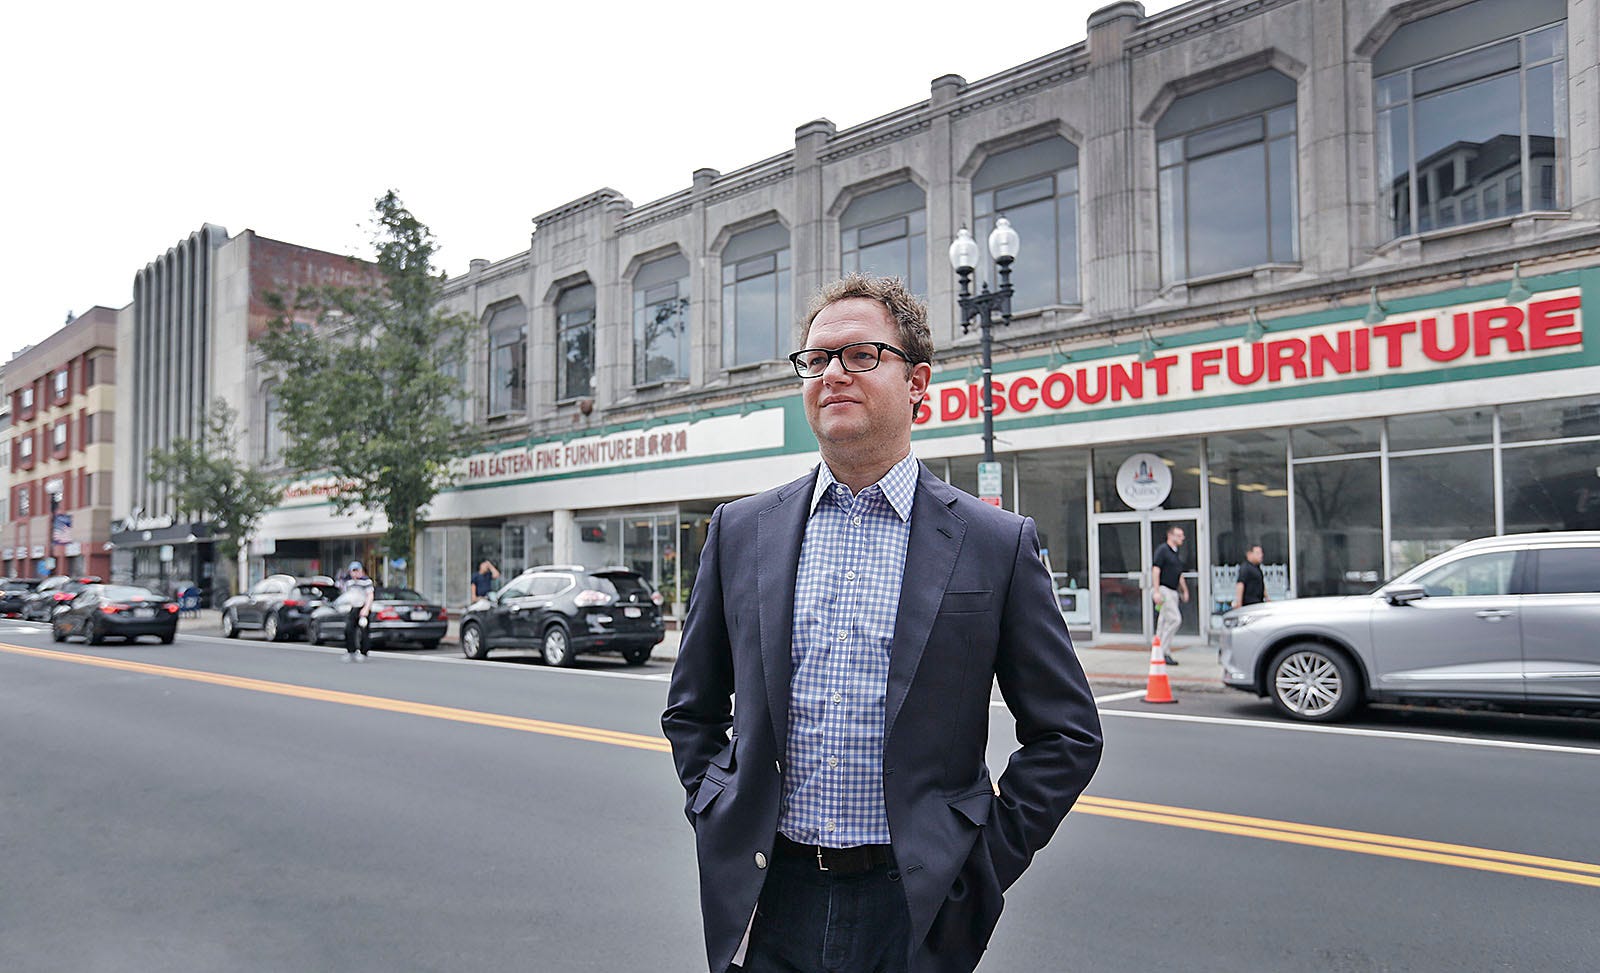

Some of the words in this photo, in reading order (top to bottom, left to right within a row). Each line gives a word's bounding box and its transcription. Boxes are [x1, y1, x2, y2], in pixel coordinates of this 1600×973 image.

[940, 355, 1178, 421] DISCOUNT
[1192, 295, 1582, 391] FURNITURE
[469, 460, 485, 479] FAR
[489, 455, 533, 476] EASTERN
[536, 449, 560, 470] FINE
[565, 438, 632, 465] FURNITURE
